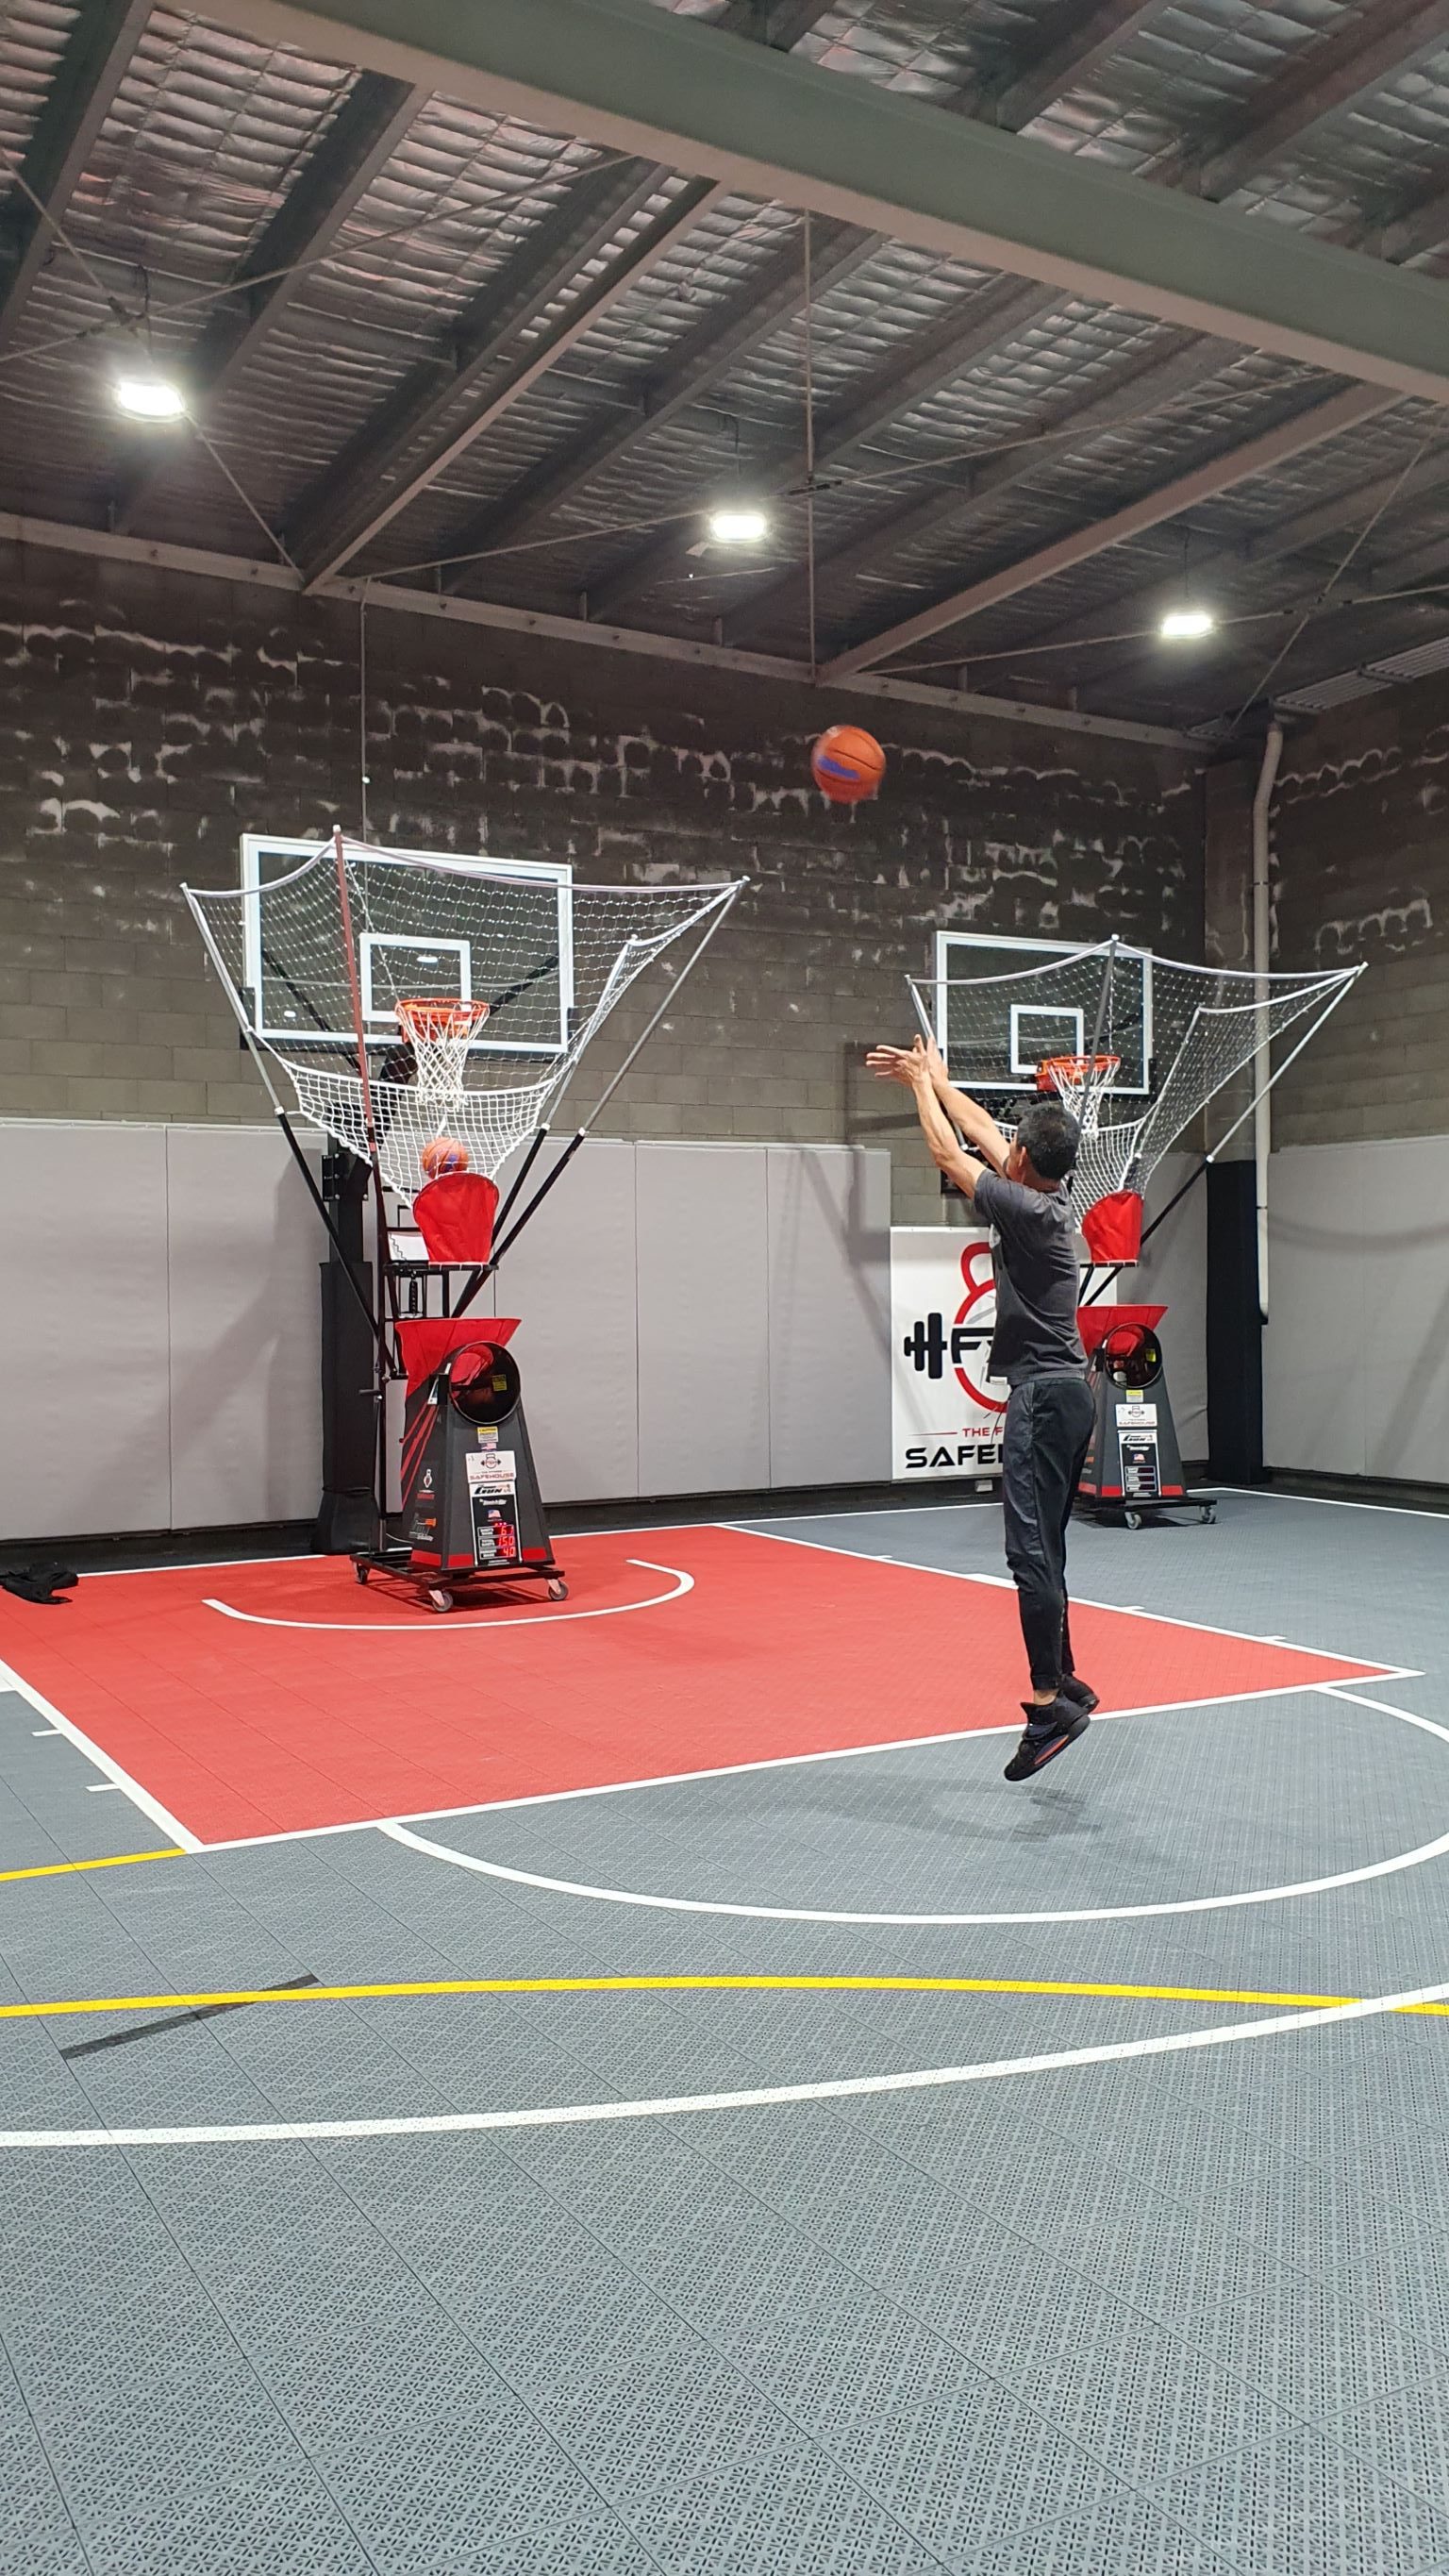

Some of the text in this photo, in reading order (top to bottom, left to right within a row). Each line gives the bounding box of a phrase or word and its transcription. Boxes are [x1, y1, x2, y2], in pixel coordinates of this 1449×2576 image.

[962, 1427, 991, 1438] THE
[498, 1535, 515, 1547] 150
[503, 1547, 516, 1557] 40
